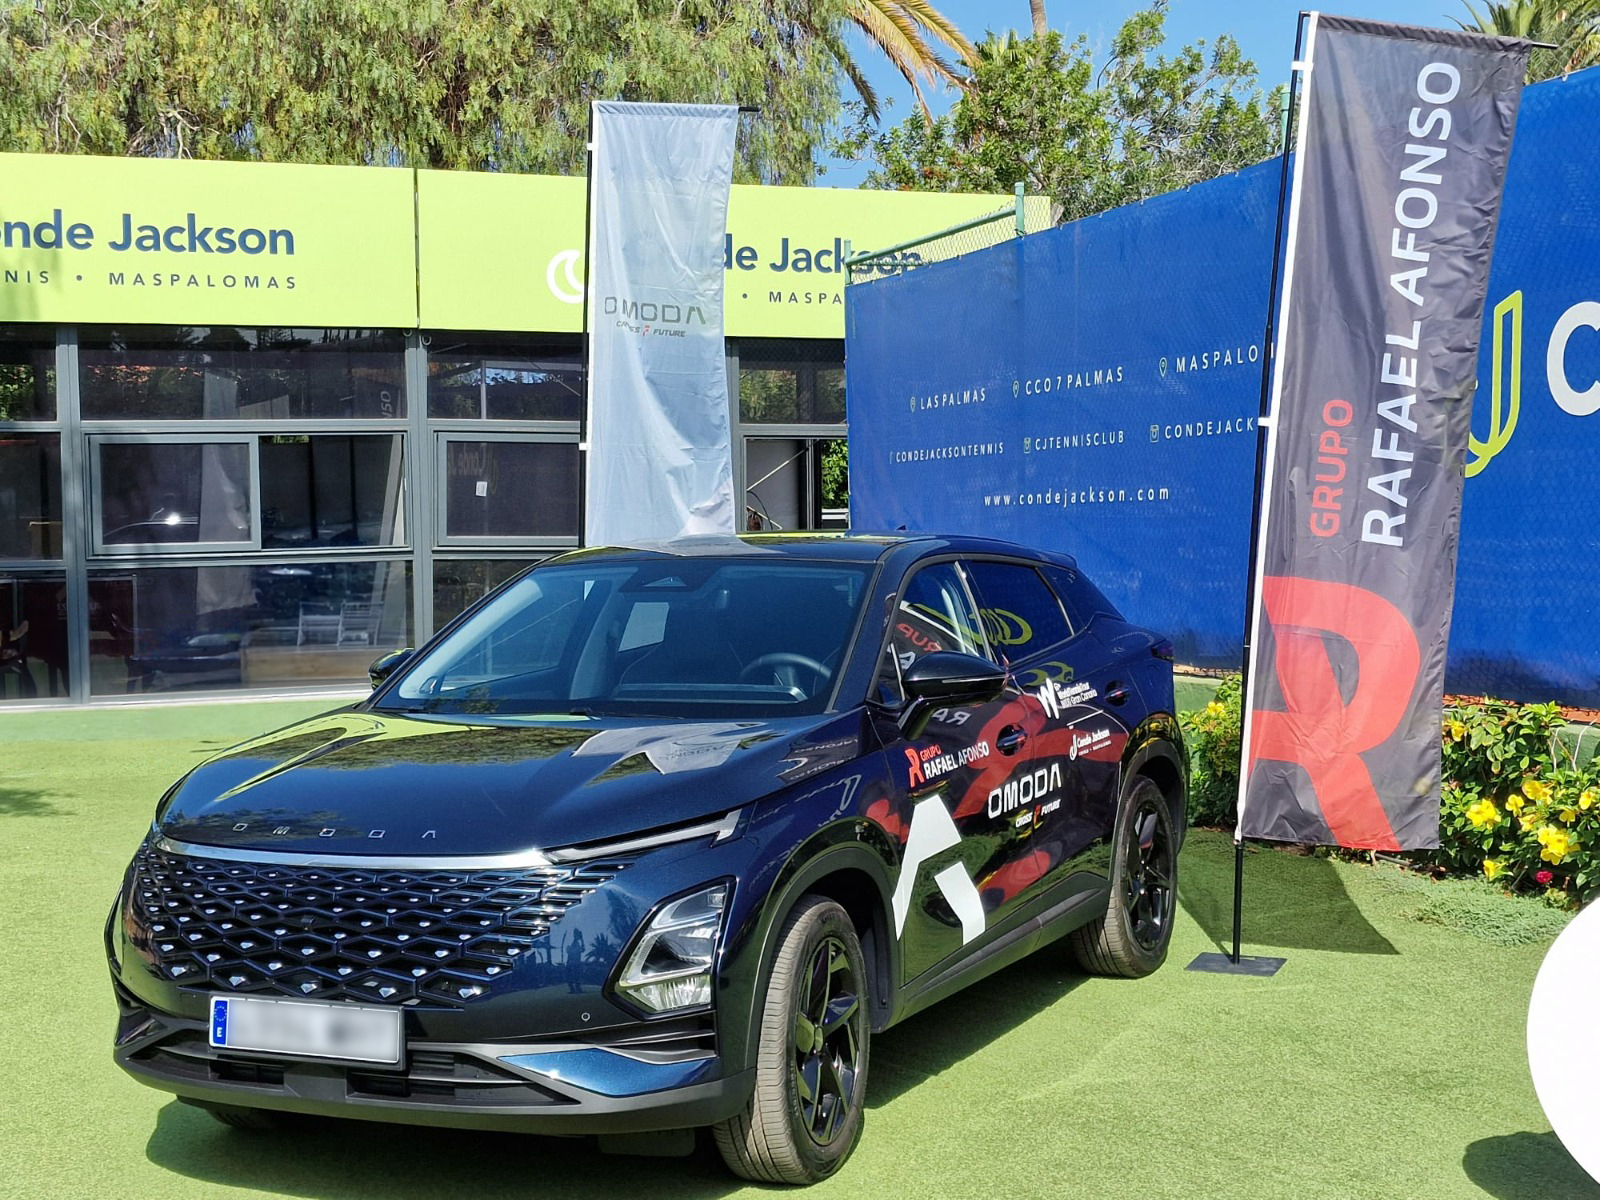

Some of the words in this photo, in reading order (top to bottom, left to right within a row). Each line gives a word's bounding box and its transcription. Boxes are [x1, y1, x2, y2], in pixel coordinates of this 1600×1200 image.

[1390, 62, 1461, 307] AFONSO
[0, 208, 95, 251] nde
[108, 212, 295, 256] Jackson
[4, 270, 50, 284] NIS
[108, 272, 297, 290] MASPALOMAS
[768, 290, 843, 305] MASPA
[604, 296, 707, 325] OMODA
[653, 328, 687, 338] FUTURE
[1176, 344, 1259, 373] MASPALO
[1066, 366, 1124, 390] PALMAS
[920, 394, 940, 411] LAS
[942, 387, 987, 408] PALMAS
[1164, 416, 1255, 440] CONDEJACK
[1361, 320, 1421, 547] RAFAEL
[895, 441, 1005, 464] CONDEJACKSONTENNIS
[1035, 430, 1125, 451] CJTENNISCLUB
[1310, 399, 1353, 538] GRUPO
[984, 485, 1170, 508] www.condejackson.com
[919, 743, 942, 763] GRUPO
[923, 753, 960, 781] RAFAEL
[957, 740, 990, 768] AFONSO
[987, 762, 1062, 820] OMODA
[216, 1026, 223, 1038] E
